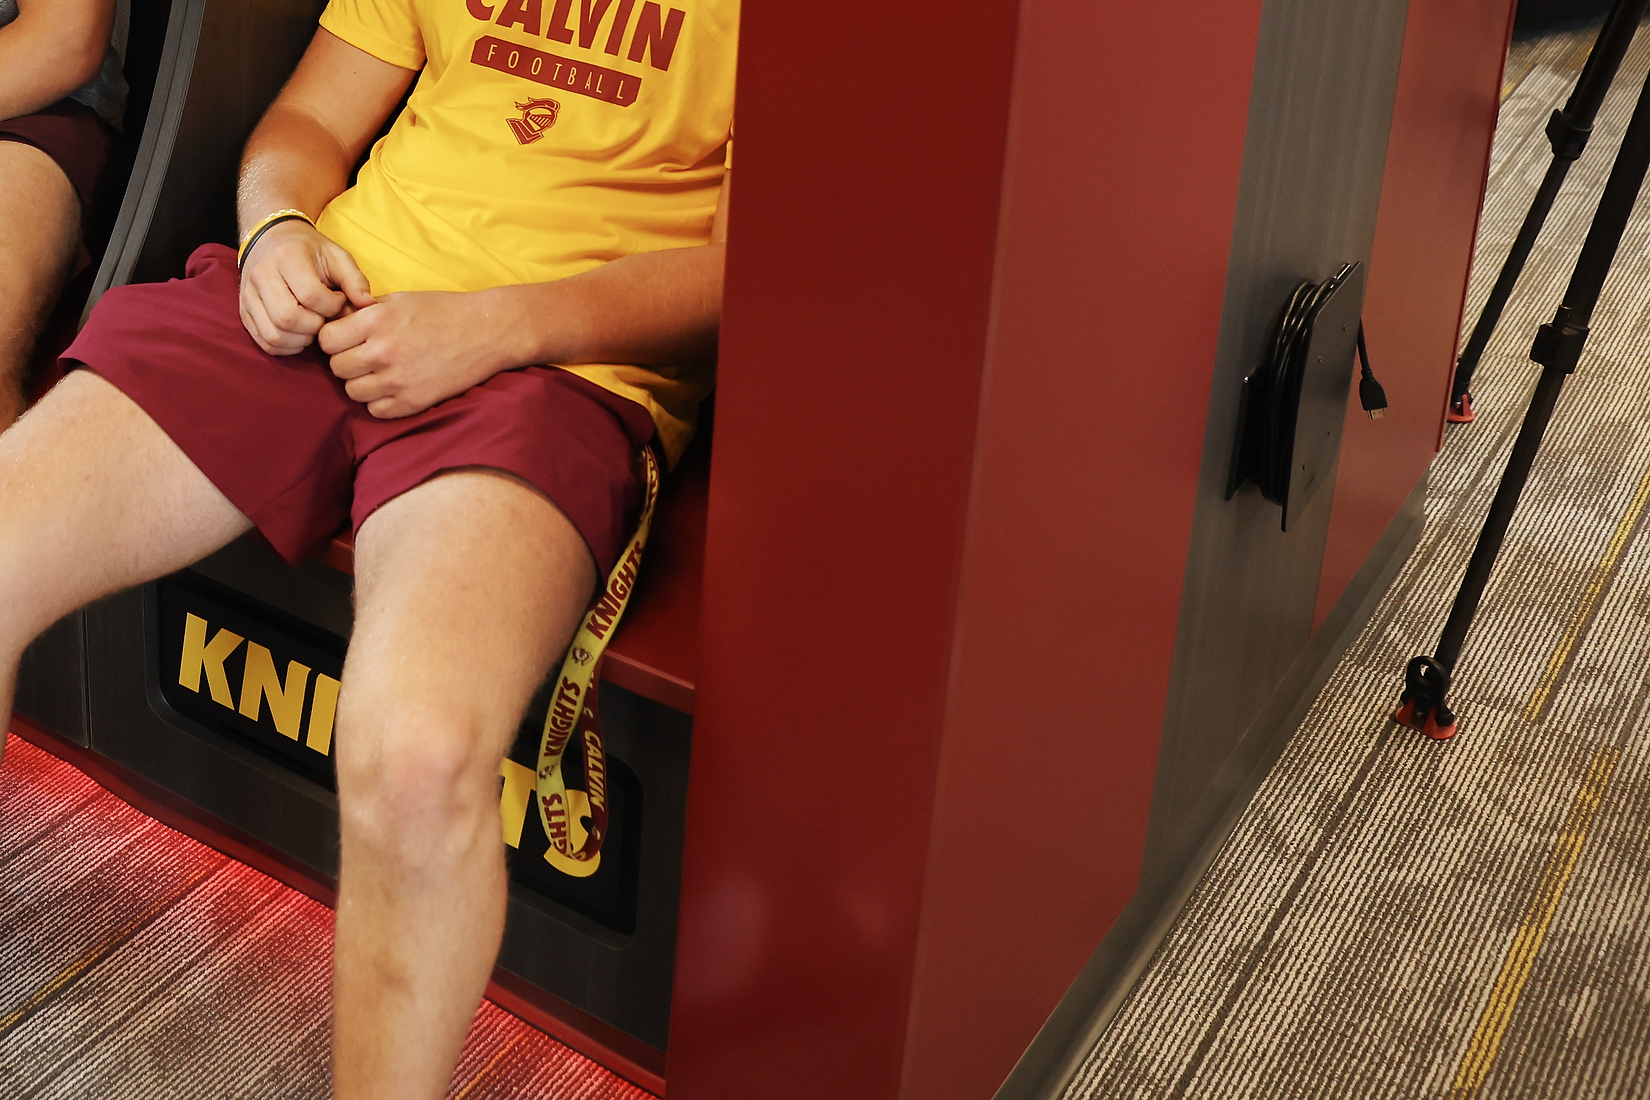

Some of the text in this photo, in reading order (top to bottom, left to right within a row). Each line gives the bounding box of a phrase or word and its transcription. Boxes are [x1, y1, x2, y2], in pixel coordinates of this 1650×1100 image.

[486, 43, 626, 101] FOOTBALL
[585, 540, 645, 641] KNIGHTS
[544, 676, 582, 757] KNIGHTS
[585, 730, 605, 812] CALVIN
